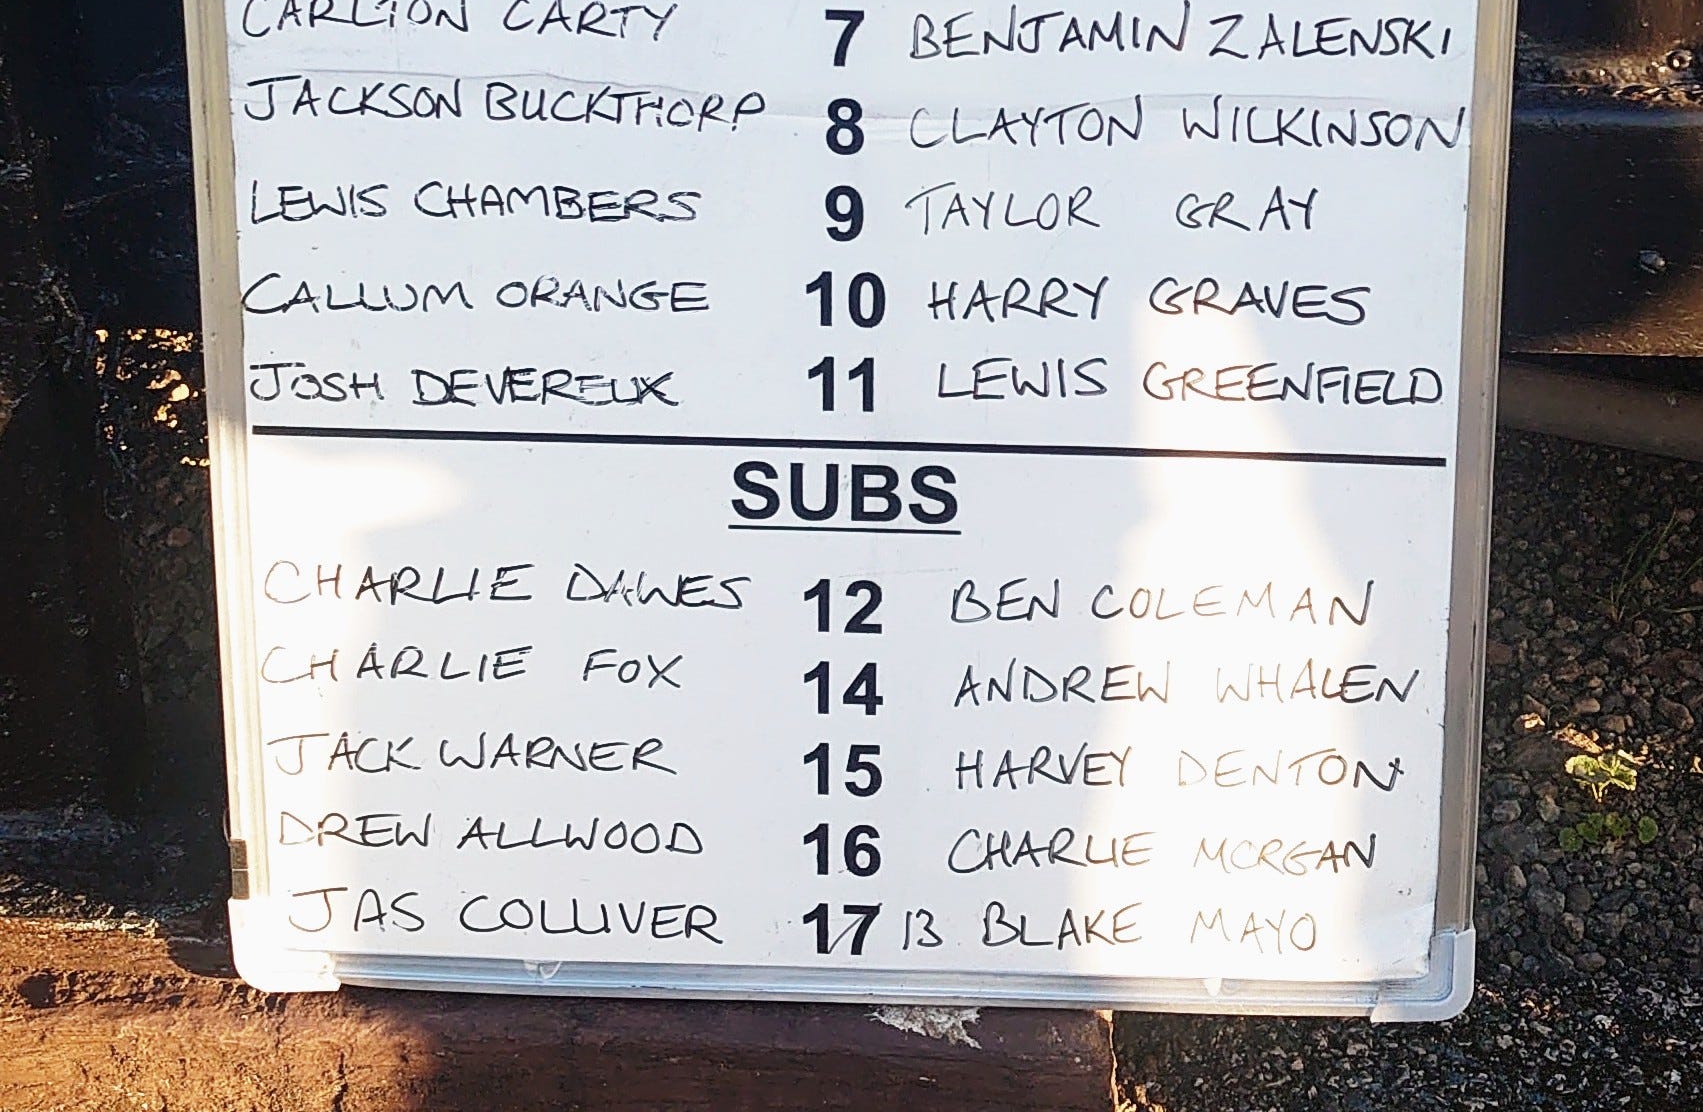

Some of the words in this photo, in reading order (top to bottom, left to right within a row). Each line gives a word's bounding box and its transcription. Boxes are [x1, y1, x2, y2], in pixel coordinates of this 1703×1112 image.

[825, 9, 864, 67] 7
[910, 0, 1190, 59] BENJAMIN
[1209, 13, 1451, 60] ZALENSKI
[244, 75, 464, 122] JACKSON
[485, 82, 765, 132] BUCKTHORP
[825, 97, 864, 155] 8
[909, 94, 1143, 149] CLAYTON
[1182, 95, 1465, 151] WILKINSON
[251, 180, 388, 224] LEWIS
[414, 181, 702, 223] CHAMBERS
[825, 185, 864, 242] 9
[905, 182, 1100, 235] TAYLOR
[1176, 185, 1318, 231] GRAY
[242, 273, 473, 315] CALLUM
[496, 275, 710, 312] ORANGE
[806, 271, 886, 328] 10
[928, 276, 1109, 323] HARRY
[1149, 277, 1371, 326] GRAVES
[249, 362, 384, 402] JOSH
[808, 356, 874, 412] 11
[938, 357, 1107, 400] LEWIS
[1143, 362, 1442, 405] GREENFIELD
[731, 461, 958, 524] SUBS
[265, 561, 535, 605] CHARLIE
[566, 563, 751, 609] DAWES
[804, 579, 882, 634] 12
[951, 578, 1059, 623] BEN
[1091, 580, 1374, 626] COLEMAN
[261, 646, 533, 683] CHARLIE
[583, 649, 683, 688] FOX
[804, 661, 883, 715] 14
[954, 658, 1170, 707] ANDREW
[1220, 658, 1419, 703] WHALEN
[267, 732, 421, 775] JACK
[440, 732, 677, 775] WARNER
[804, 743, 882, 797] 15
[955, 742, 1132, 790] HARVEY
[279, 811, 431, 847] DREW
[456, 816, 703, 854] ALLWOOD
[803, 823, 881, 877] 16
[948, 828, 1154, 873] CHARLIE
[1193, 833, 1376, 877] MORGAN
[289, 887, 425, 932] JAS
[459, 895, 723, 944] COLLIVER
[803, 903, 882, 957] 17
[902, 909, 943, 950] 13
[982, 901, 1142, 950] BLAKE
[1191, 909, 1316, 954] MAYO
